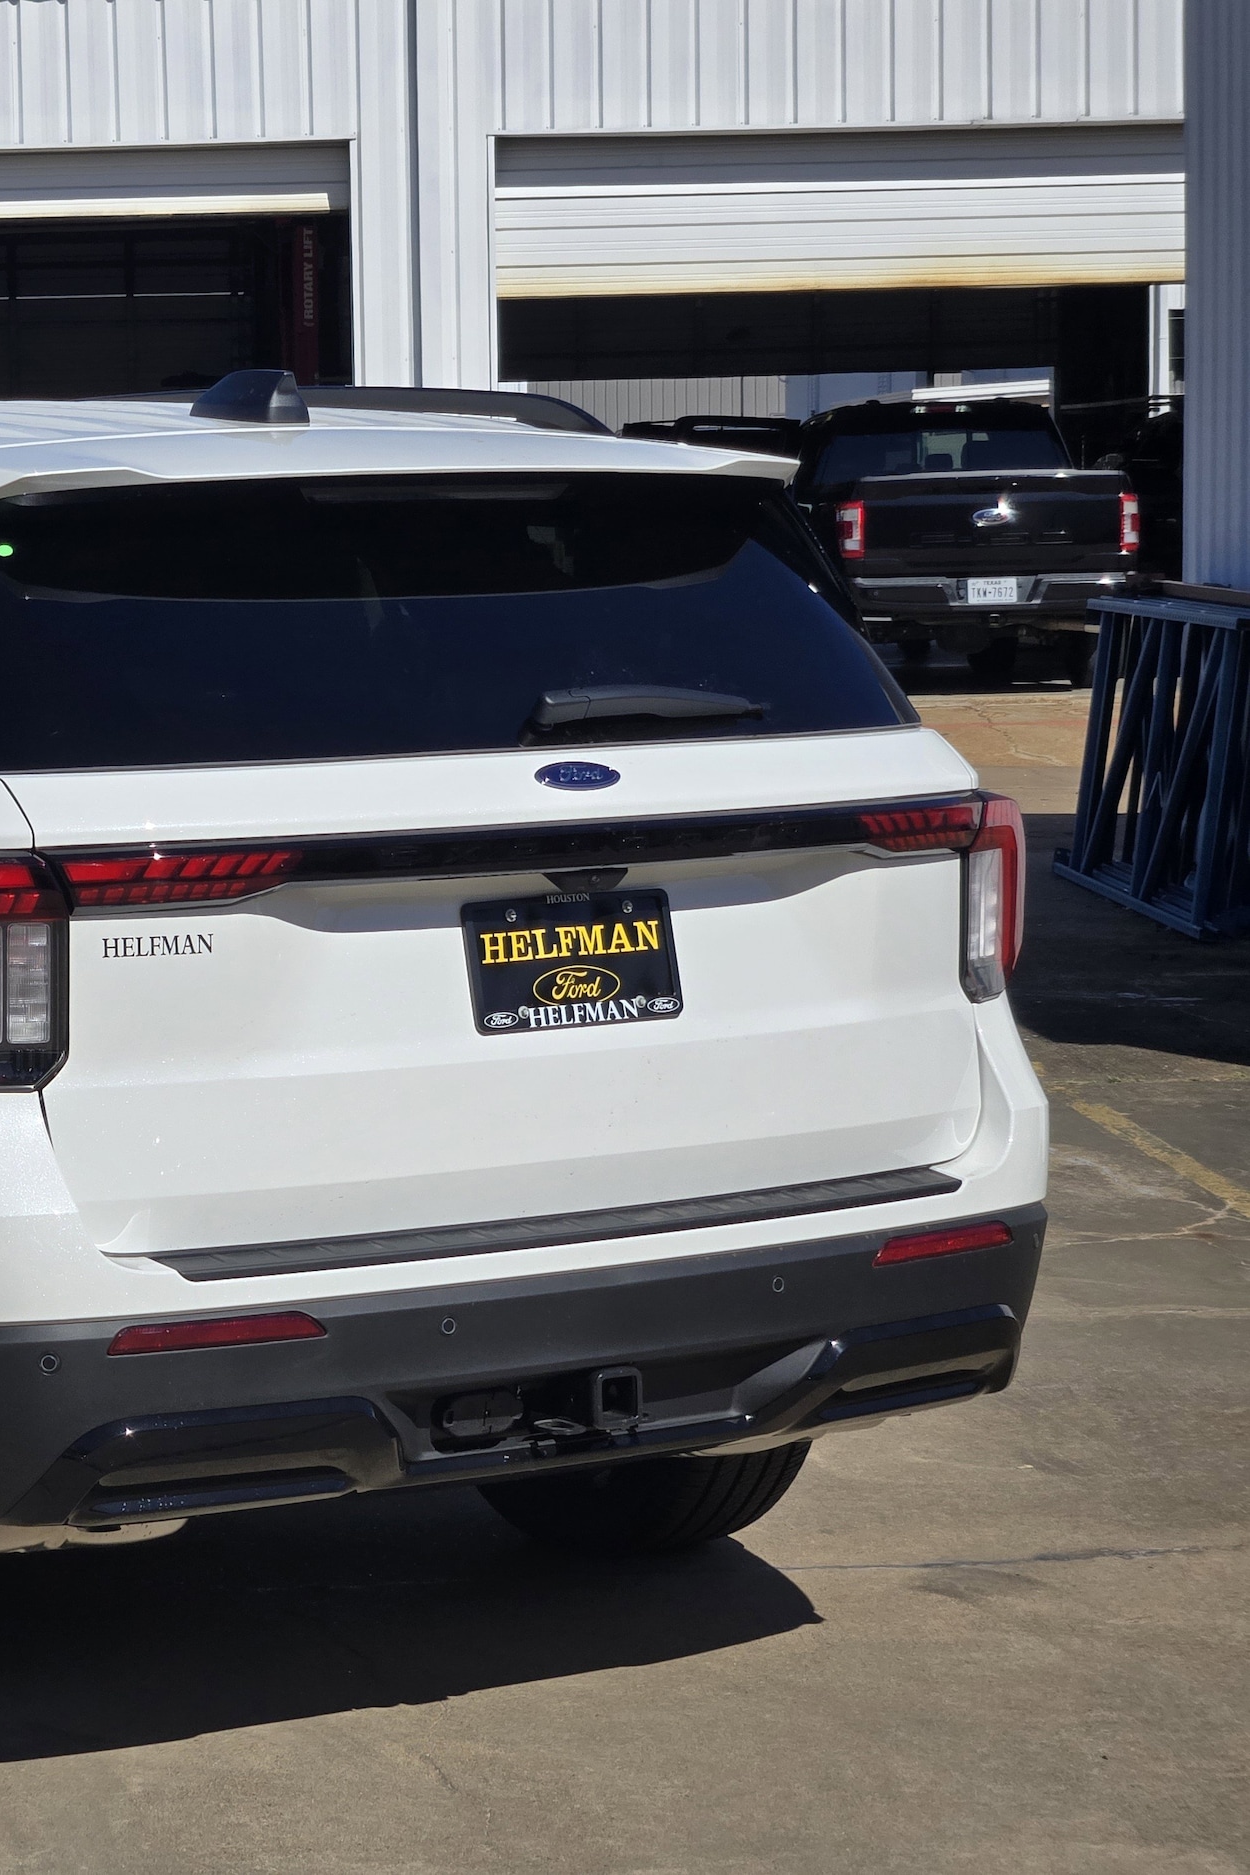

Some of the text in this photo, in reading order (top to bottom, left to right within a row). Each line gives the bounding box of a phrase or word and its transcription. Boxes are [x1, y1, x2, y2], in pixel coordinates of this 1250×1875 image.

[558, 764, 604, 782] Ford
[546, 892, 591, 905] HOUSTON
[101, 933, 215, 959] HELFMAN
[479, 919, 660, 965] HELFMAN
[551, 970, 602, 1001] Ford
[528, 998, 639, 1028] HELFMAN
[653, 998, 676, 1011] Ford
[489, 1013, 514, 1027] Ford
